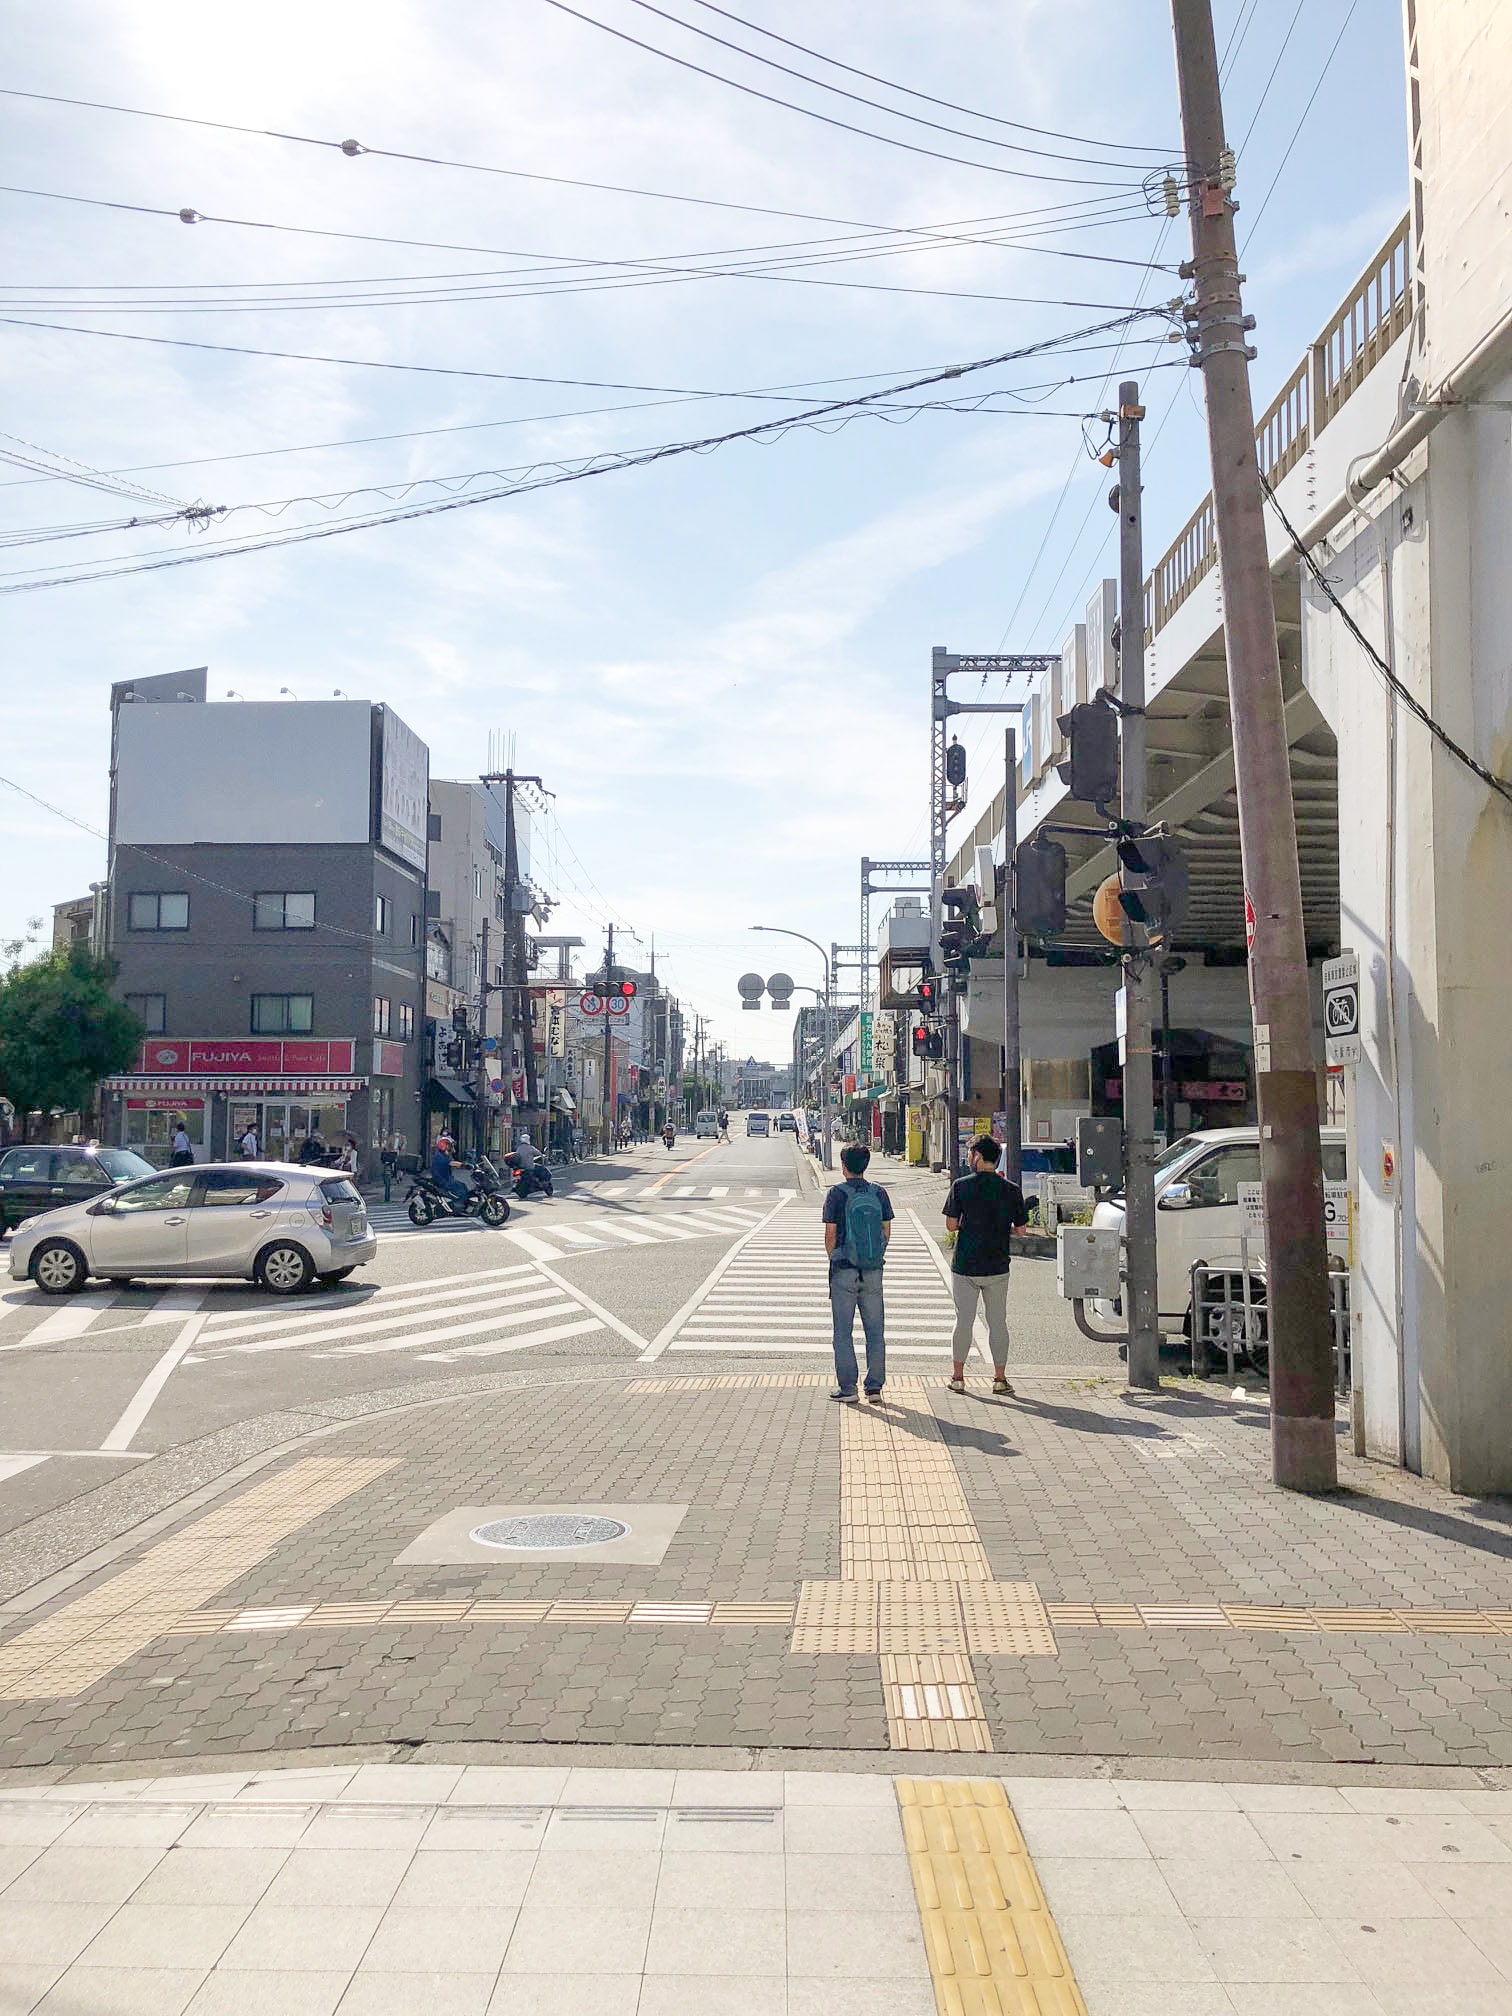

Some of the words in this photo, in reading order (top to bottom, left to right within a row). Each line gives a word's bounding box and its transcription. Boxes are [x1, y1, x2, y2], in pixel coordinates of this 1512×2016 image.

[611, 998, 625, 1010] 30
[192, 1052, 252, 1062] FUJIYA
[1324, 1201, 1336, 1221] G
